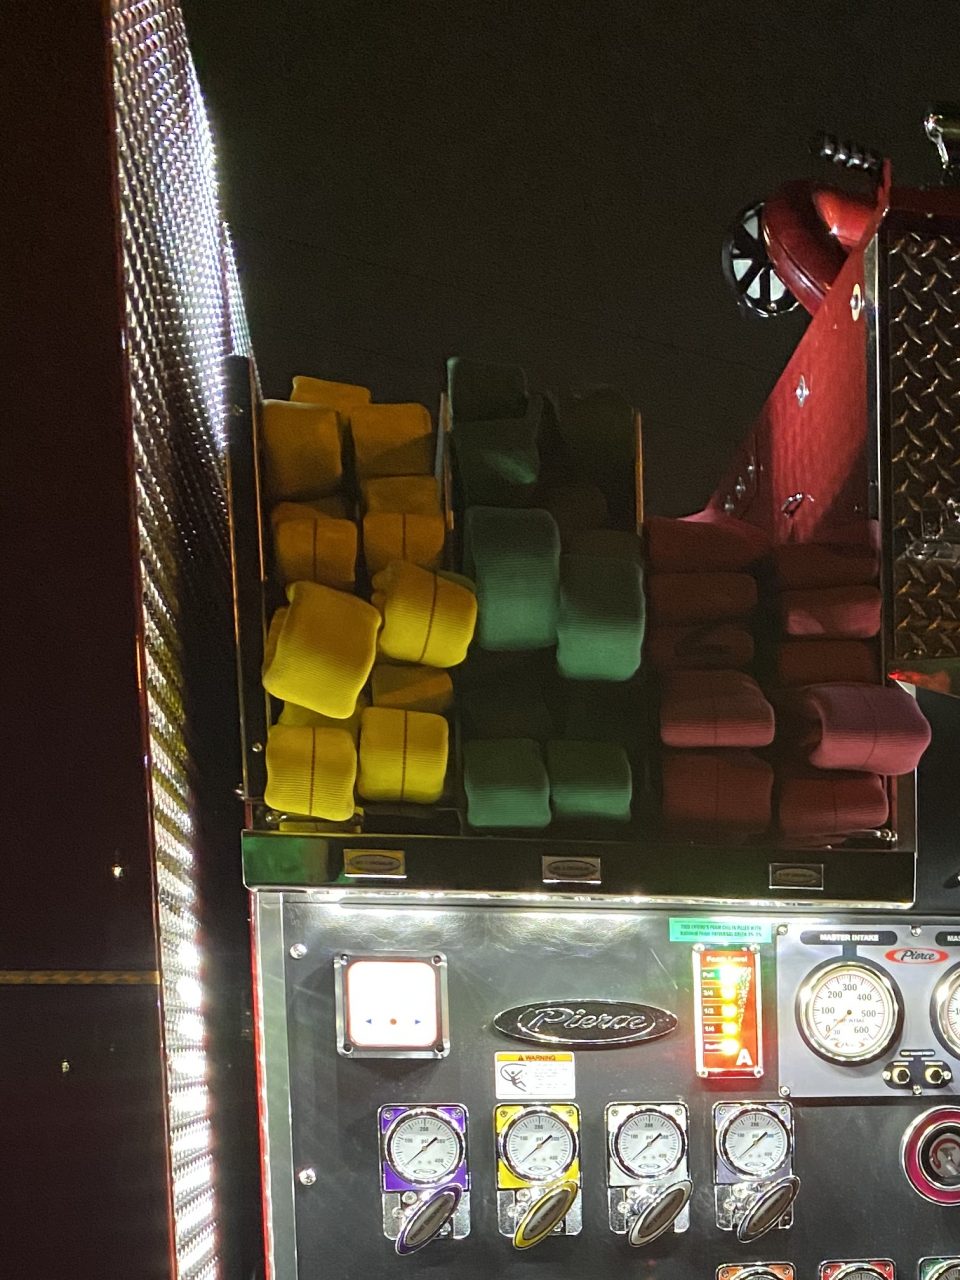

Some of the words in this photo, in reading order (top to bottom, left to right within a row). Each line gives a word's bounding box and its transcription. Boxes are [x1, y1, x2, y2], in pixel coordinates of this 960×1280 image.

[900, 949, 935, 962] Pierce
[842, 984, 857, 992] 300
[828, 991, 842, 999] 200
[857, 993, 872, 1001] 400
[821, 1007, 835, 1015] 100
[861, 1010, 876, 1018] 500
[528, 1007, 647, 1032] Pierce
[854, 1026, 869, 1034] 600
[736, 1048, 752, 1065] A
